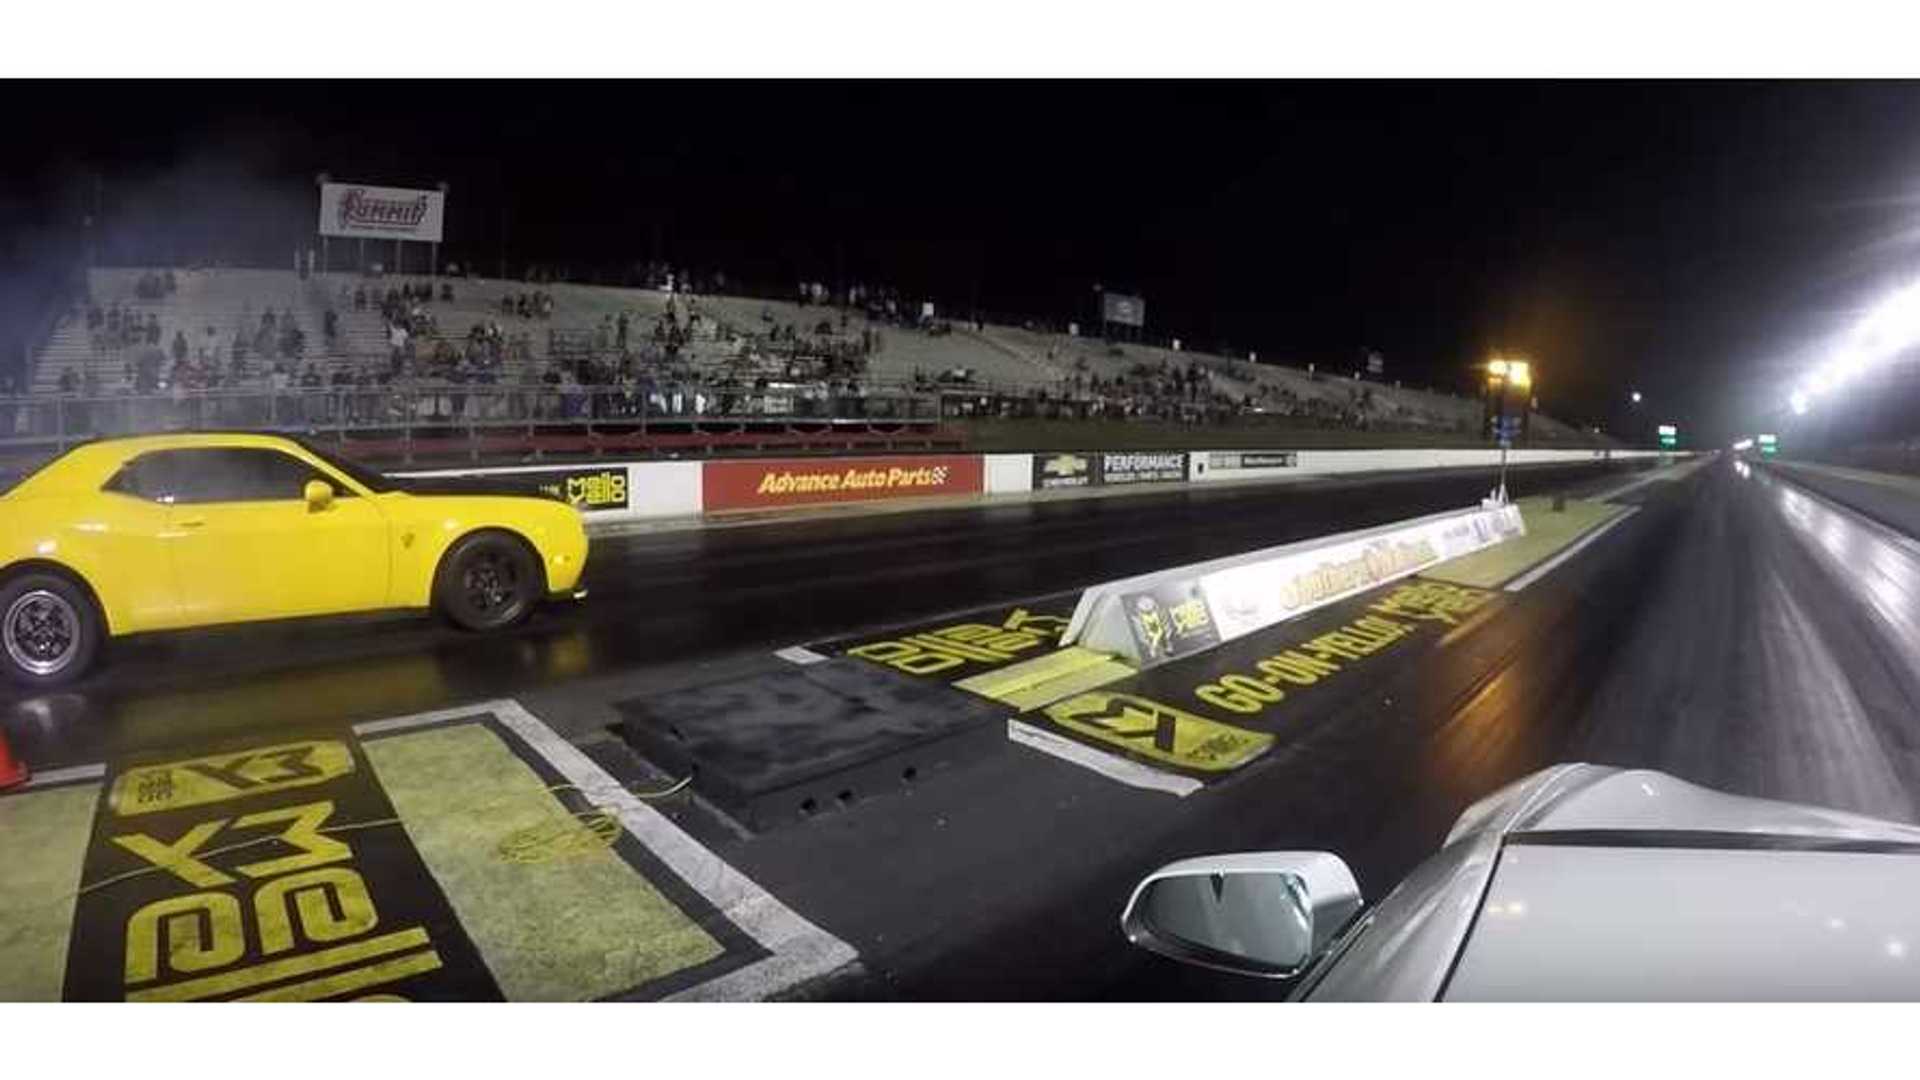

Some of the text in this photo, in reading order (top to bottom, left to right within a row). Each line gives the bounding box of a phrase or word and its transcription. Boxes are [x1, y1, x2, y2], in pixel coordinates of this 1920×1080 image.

[757, 467, 932, 494] Advance Auto Parts
